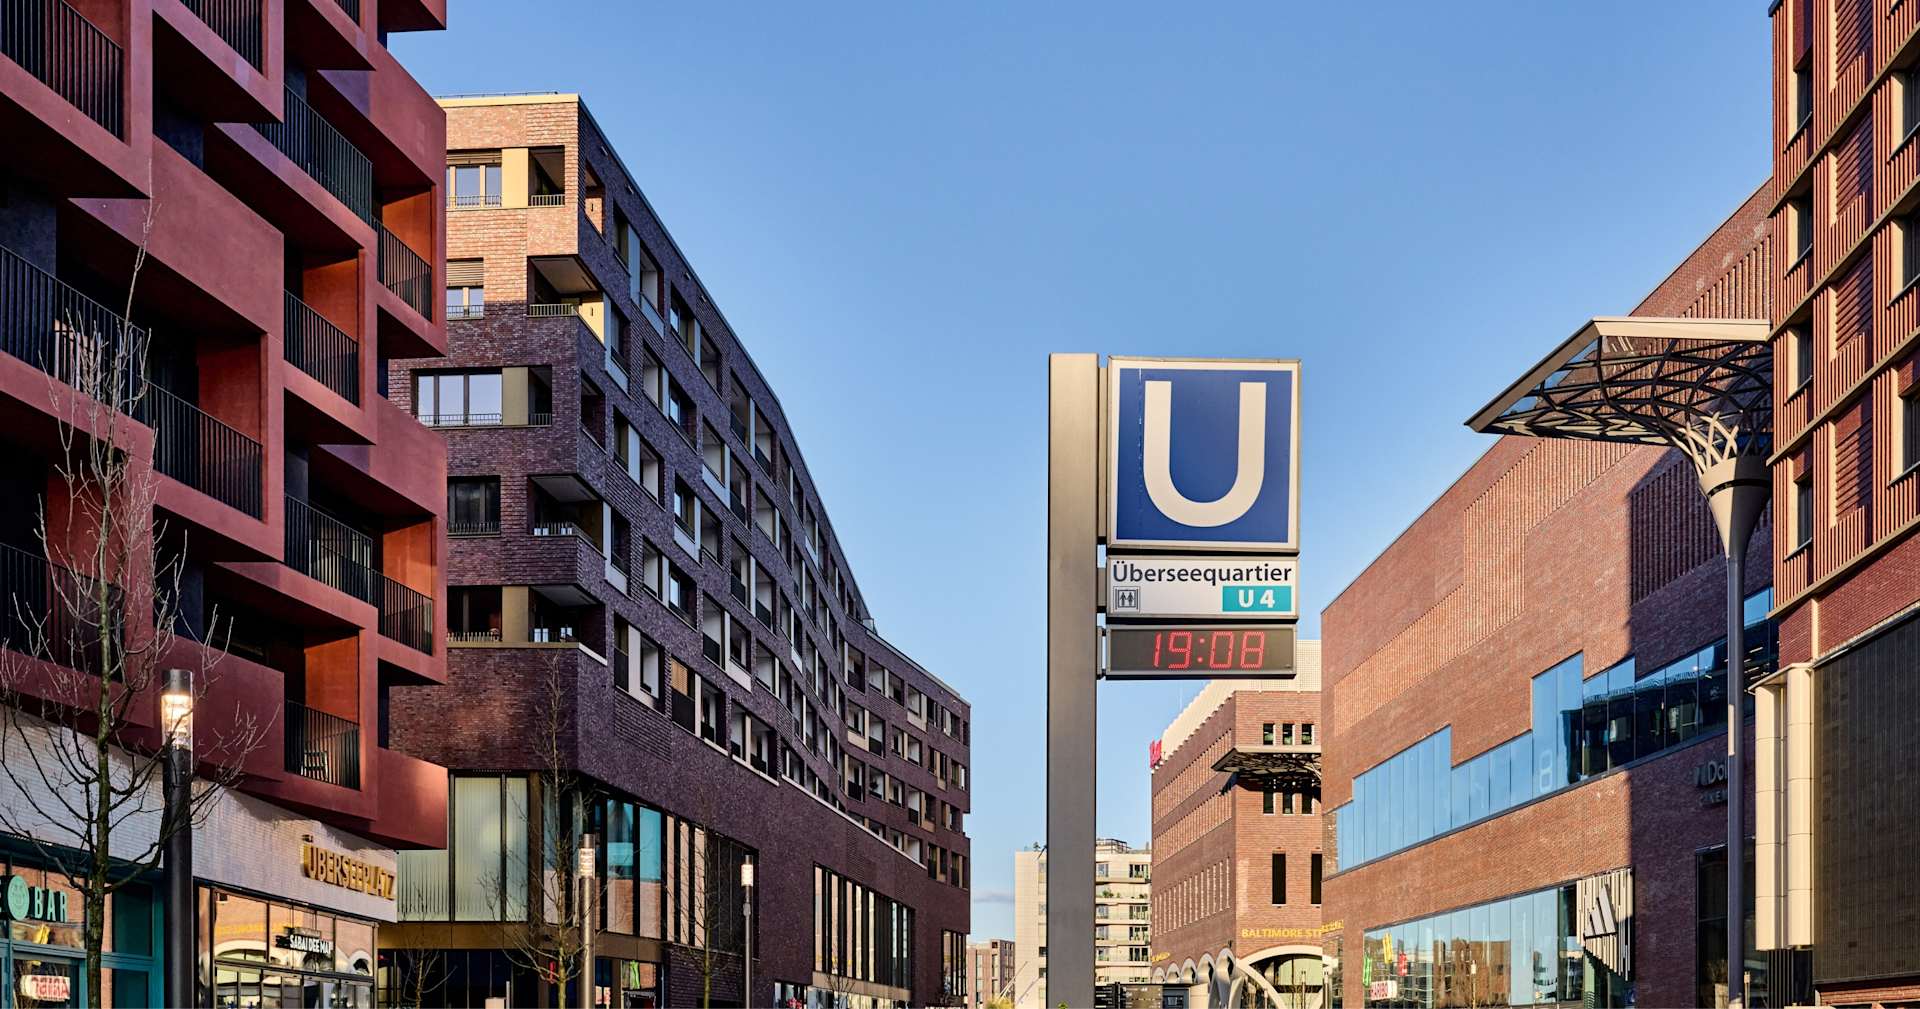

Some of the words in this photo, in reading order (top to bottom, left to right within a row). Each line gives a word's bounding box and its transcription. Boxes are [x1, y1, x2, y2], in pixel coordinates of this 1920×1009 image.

[1143, 380, 1266, 527] U
[1112, 561, 1292, 586] Überseequartier
[1238, 589, 1255, 608] U
[1260, 589, 1275, 608] 4
[1154, 631, 1265, 668] 19:08
[1708, 760, 1728, 784] Dol
[302, 834, 397, 901] ÜBERSEEPLATZ
[34, 887, 67, 923] BAR
[290, 934, 308, 950] SABAI
[308, 938, 320, 953] DEE
[1241, 928, 1303, 938] BALTIMORE
